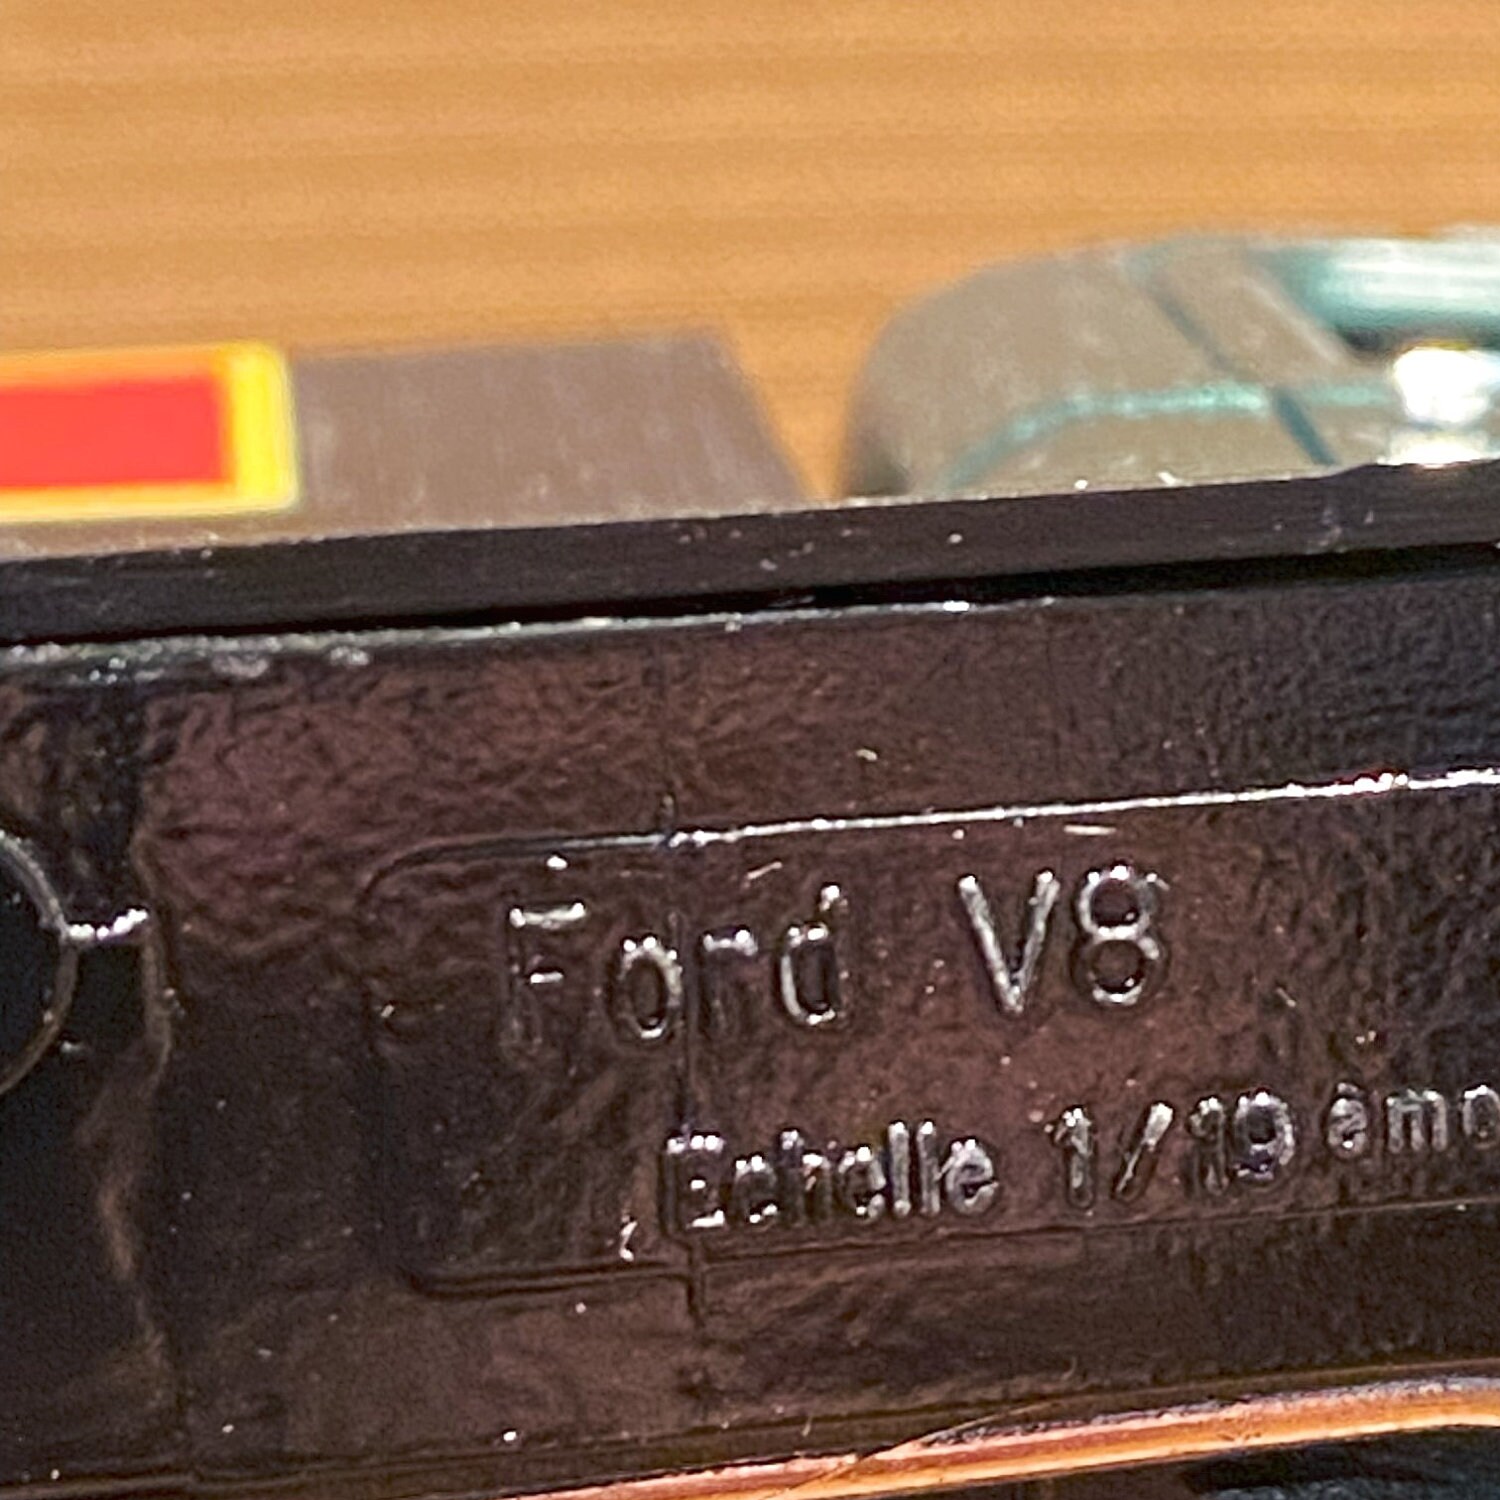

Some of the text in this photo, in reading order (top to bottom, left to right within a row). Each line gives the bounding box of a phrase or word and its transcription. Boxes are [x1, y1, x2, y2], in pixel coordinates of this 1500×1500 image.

[503, 860, 1168, 1055] Ford V8
[663, 1116, 999, 1228] Echelle
